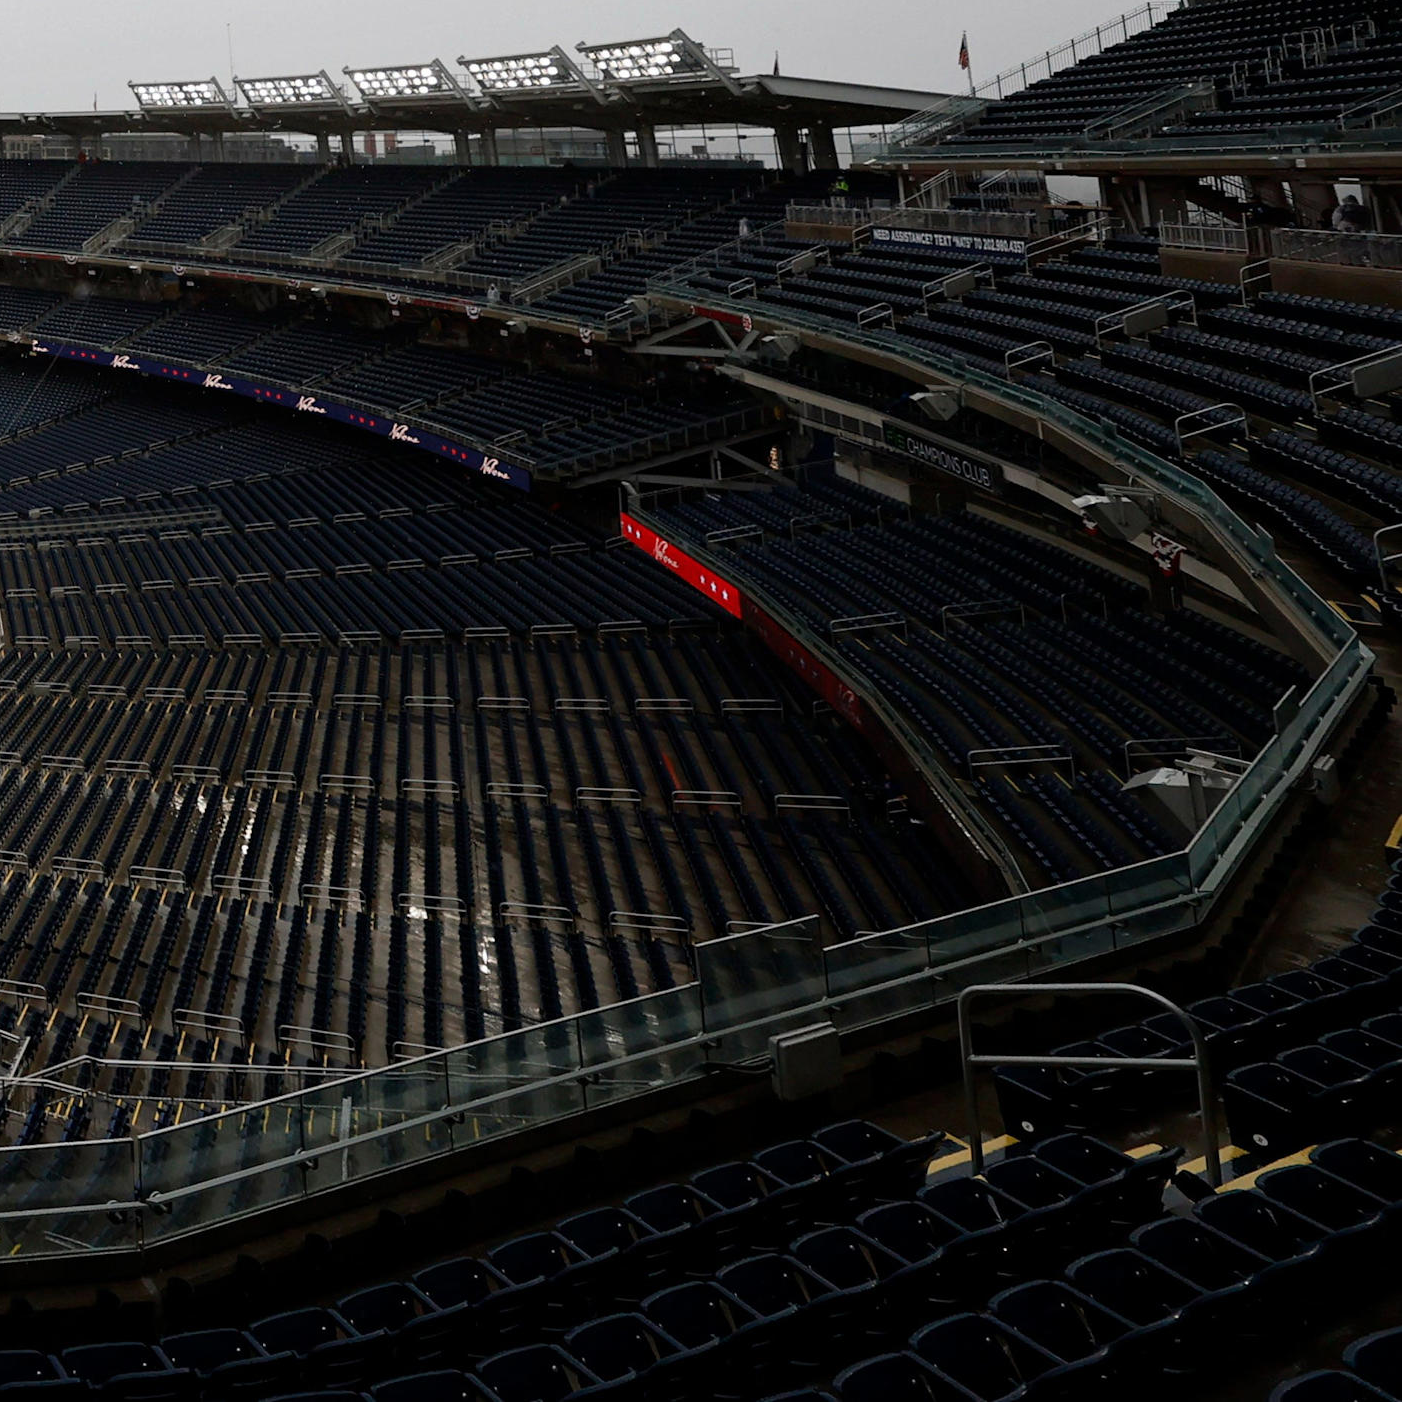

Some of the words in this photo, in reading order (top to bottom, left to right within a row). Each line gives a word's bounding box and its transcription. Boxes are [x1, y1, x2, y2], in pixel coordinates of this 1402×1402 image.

[873, 228, 890, 240] NEED
[891, 230, 933, 245] ASSISTANCE?
[933, 234, 952, 246] TEXT
[974, 237, 983, 249] TO
[907, 437, 962, 475] CHAMPIONS
[962, 460, 991, 487] CLUB
